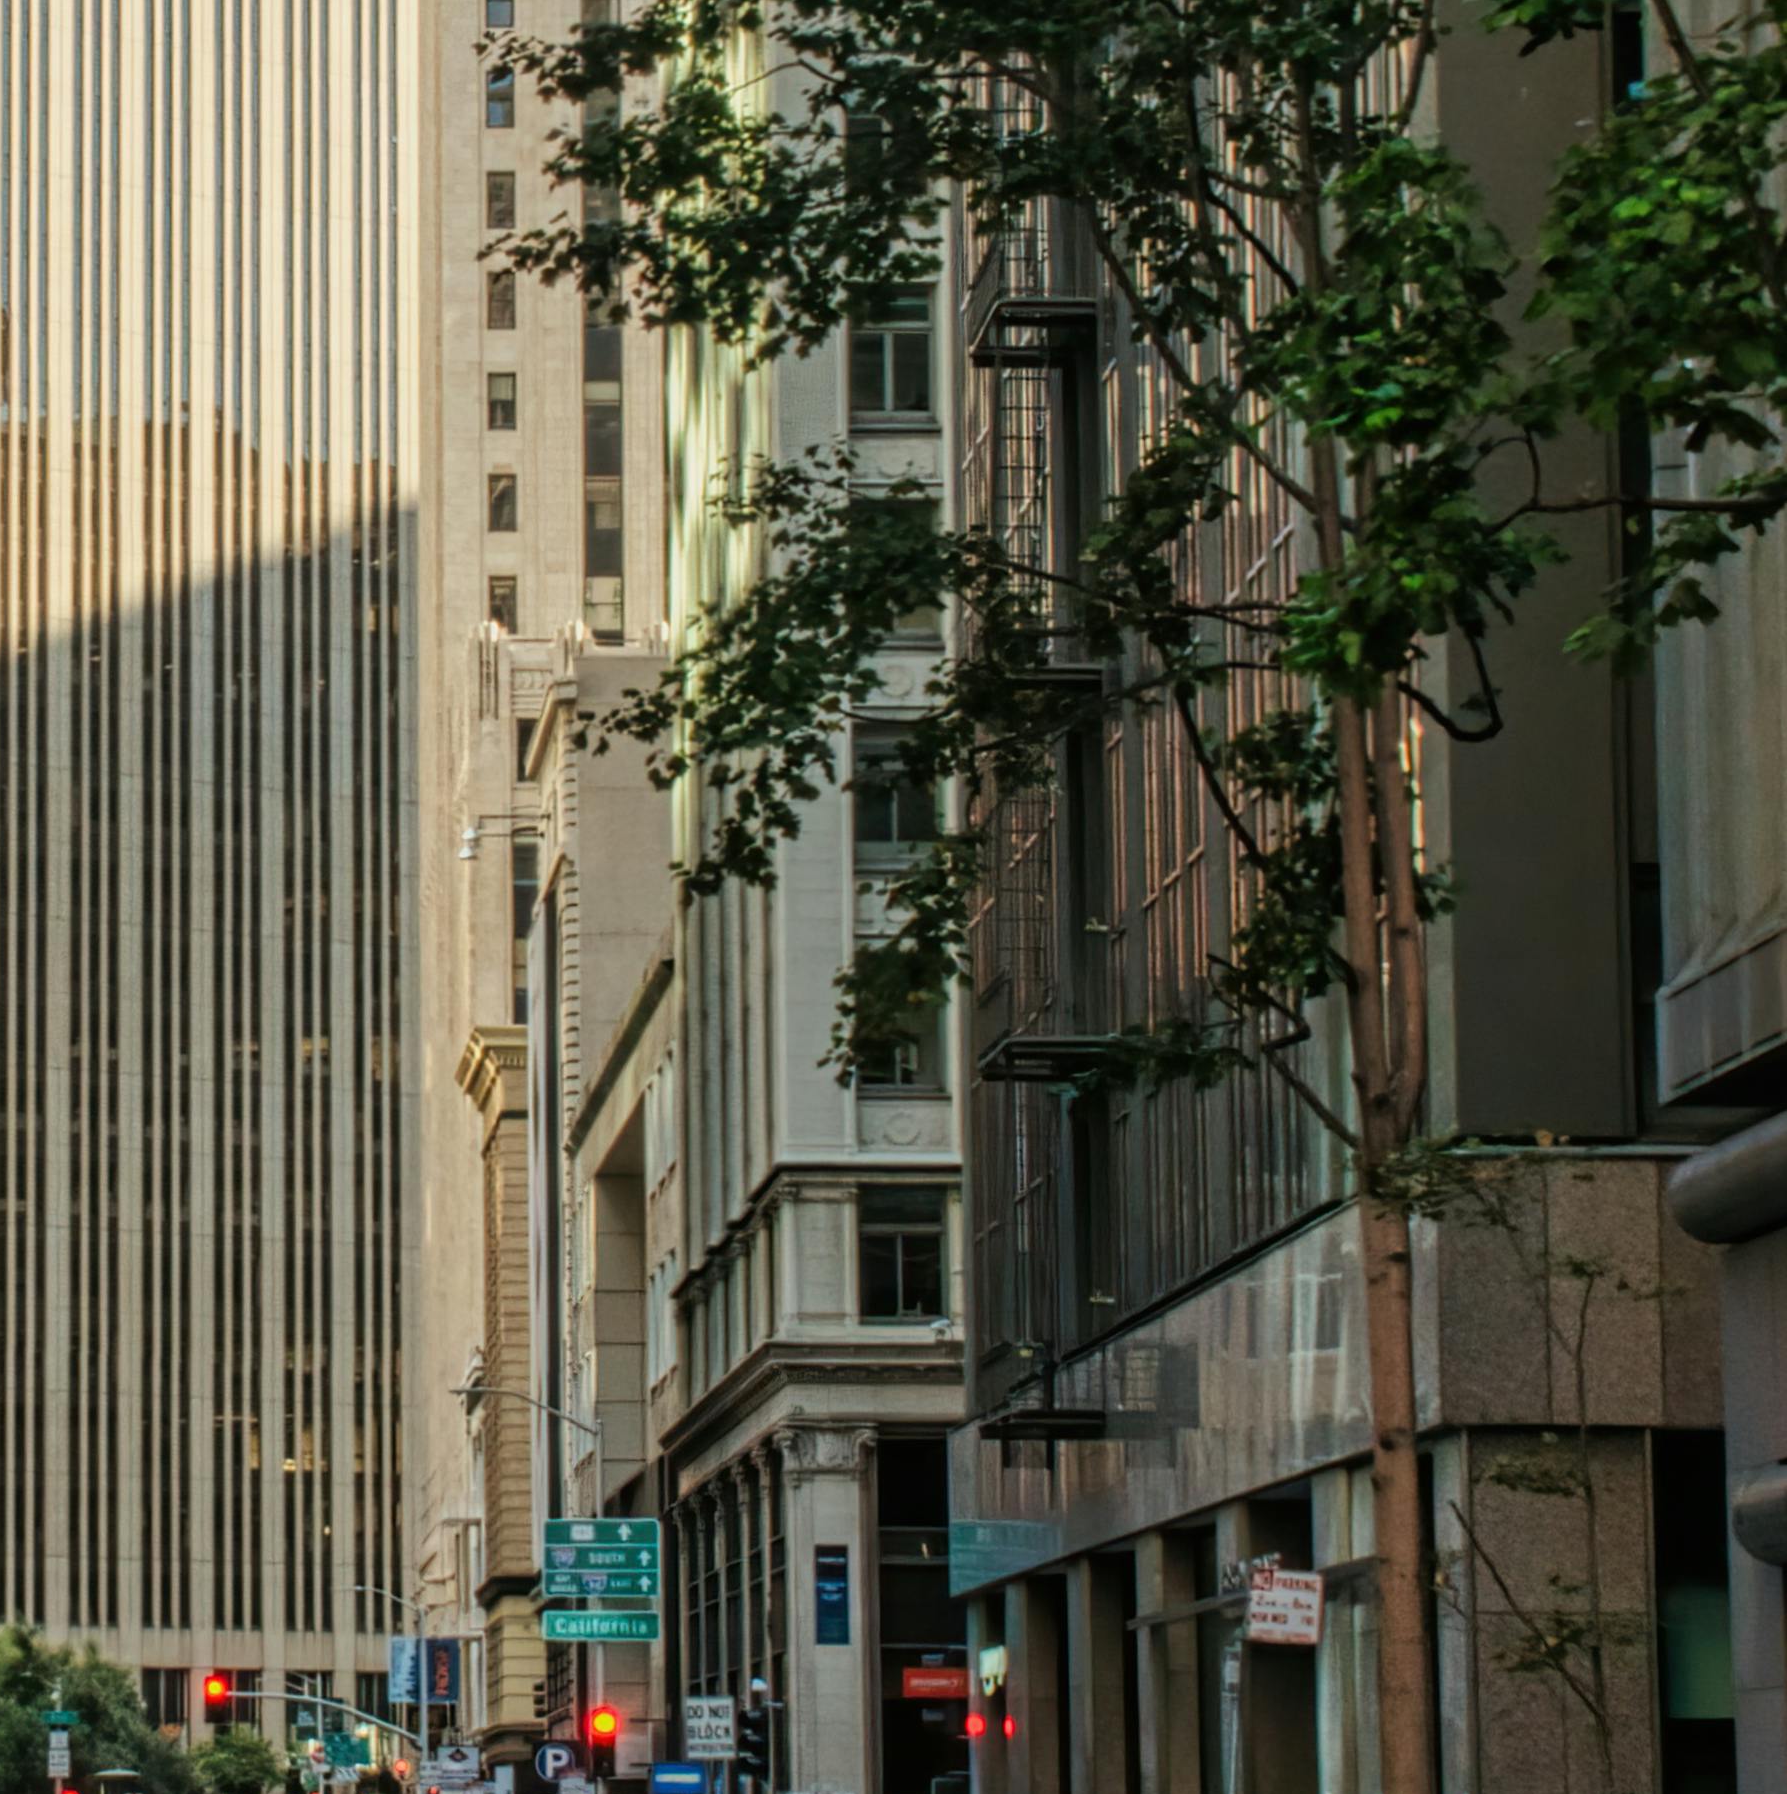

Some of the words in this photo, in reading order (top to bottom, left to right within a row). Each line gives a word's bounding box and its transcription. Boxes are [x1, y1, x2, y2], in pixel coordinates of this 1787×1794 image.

[555, 1617, 648, 1635] California
[686, 1705, 703, 1719] DO
[708, 1705, 731, 1719] NOT
[687, 1725, 732, 1739] BLOCK
